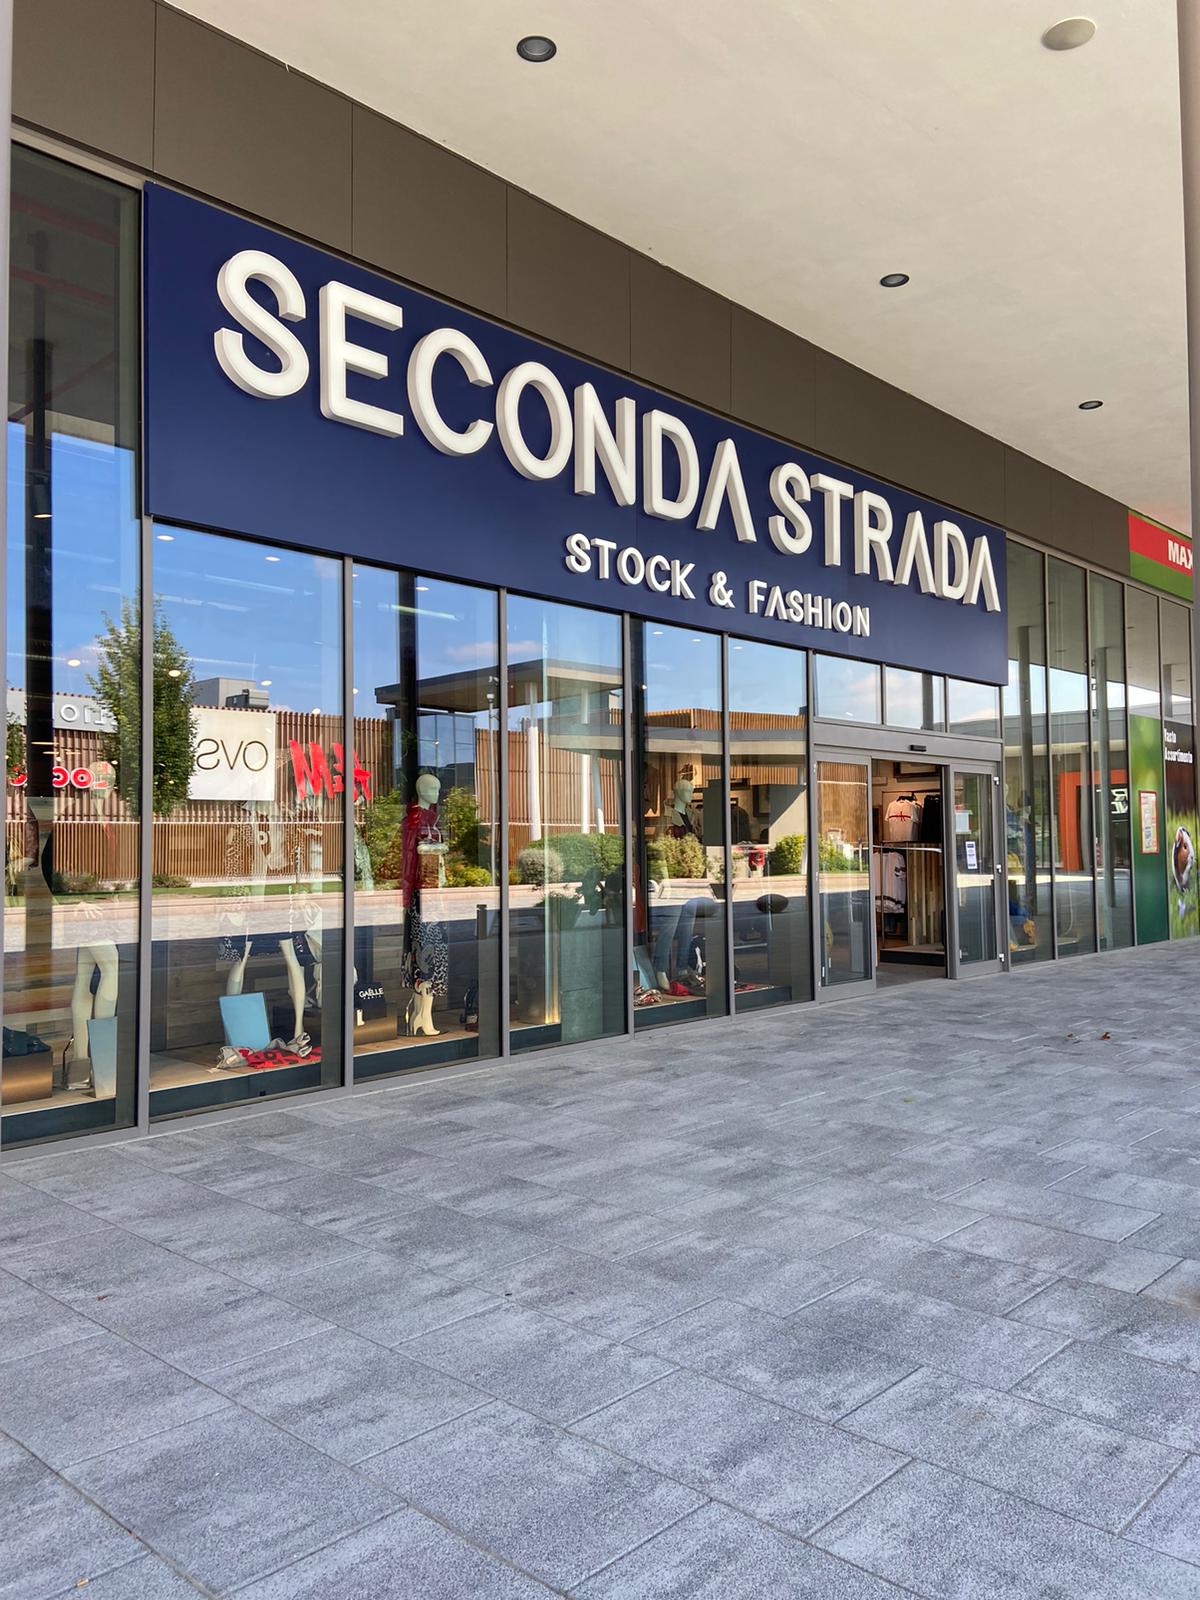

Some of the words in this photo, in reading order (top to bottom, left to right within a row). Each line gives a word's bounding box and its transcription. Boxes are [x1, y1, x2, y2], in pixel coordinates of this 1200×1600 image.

[214, 250, 757, 543] SECONDA
[768, 462, 1001, 612] STRADA
[565, 533, 695, 599] STOCK
[709, 571, 735, 608] &
[748, 580, 871, 637] FASHION
